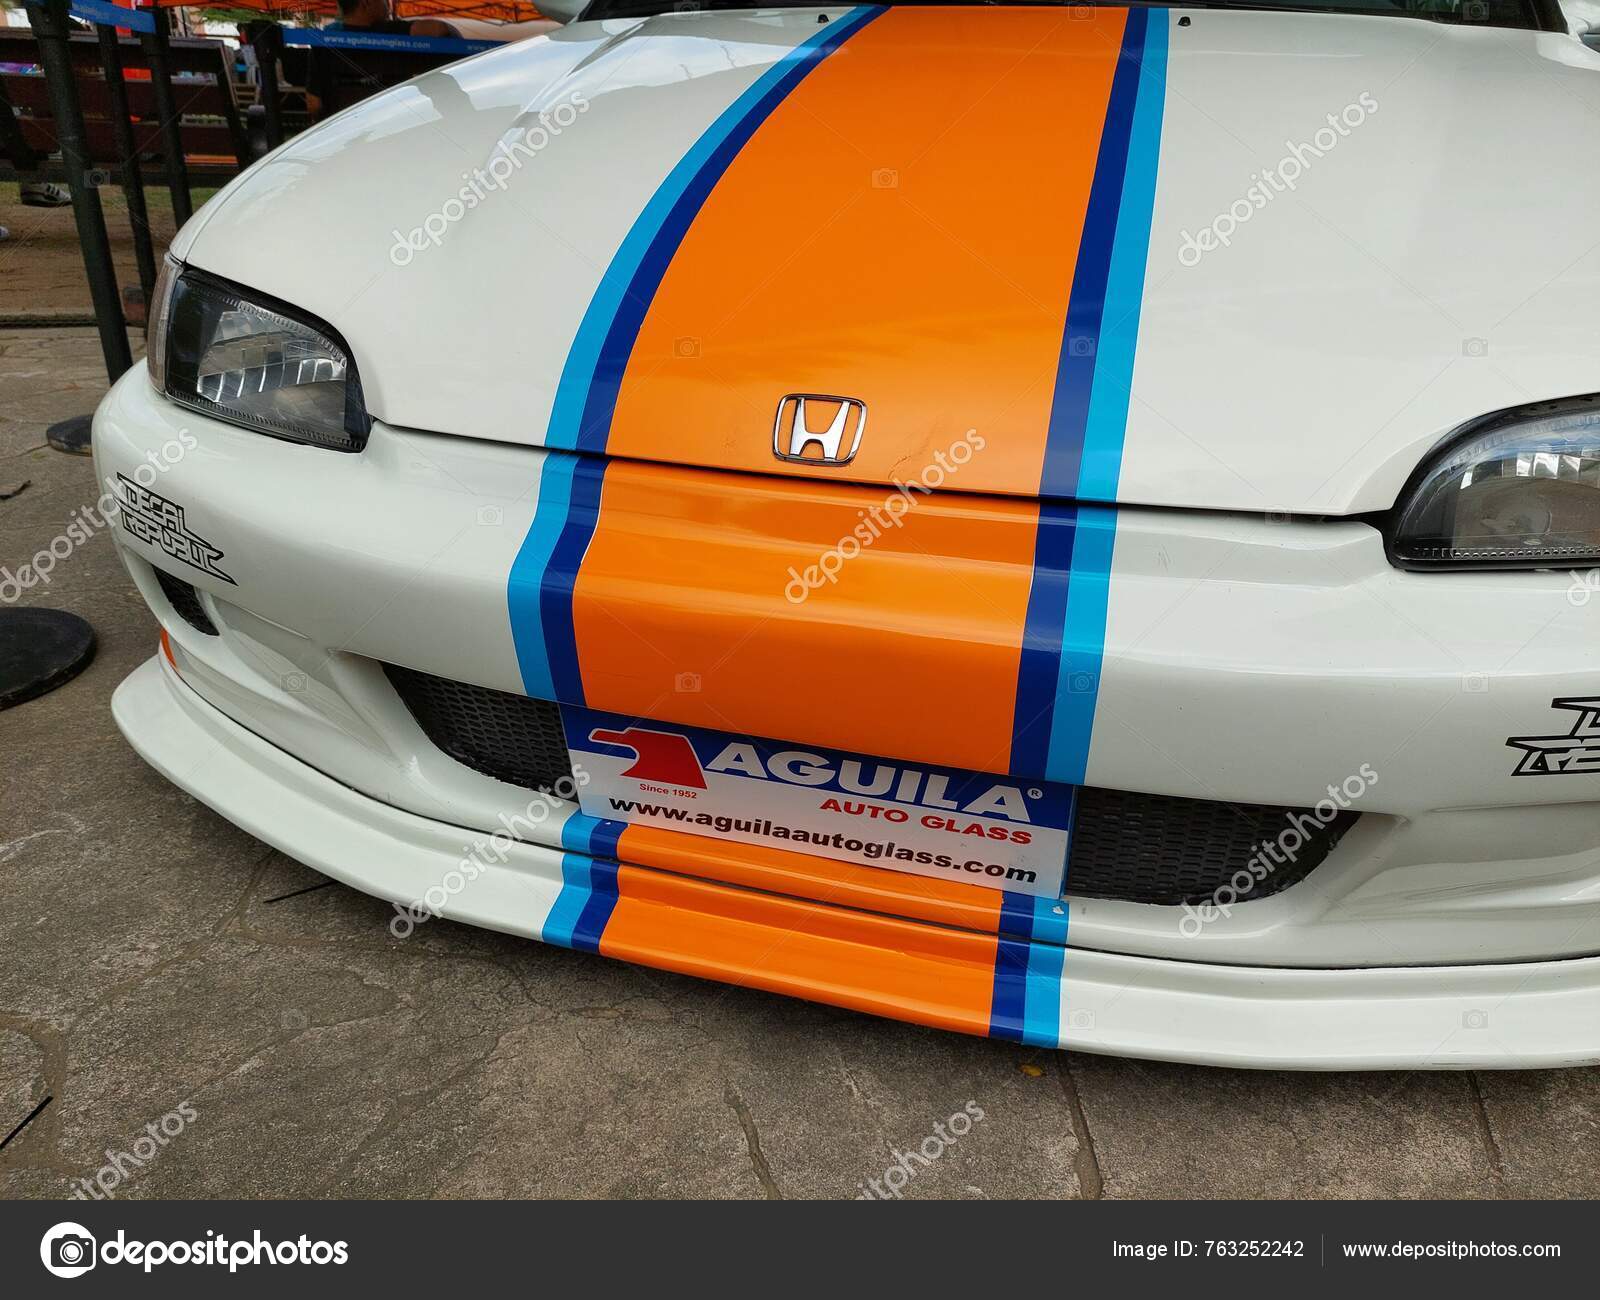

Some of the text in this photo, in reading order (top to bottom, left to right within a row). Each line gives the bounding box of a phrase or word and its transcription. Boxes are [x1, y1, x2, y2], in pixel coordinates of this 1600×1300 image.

[639, 783, 698, 799] Since 1952
[608, 797, 1037, 883] www.aguilaautoglass.com
[819, 798, 1033, 845] AUTO GLASS
